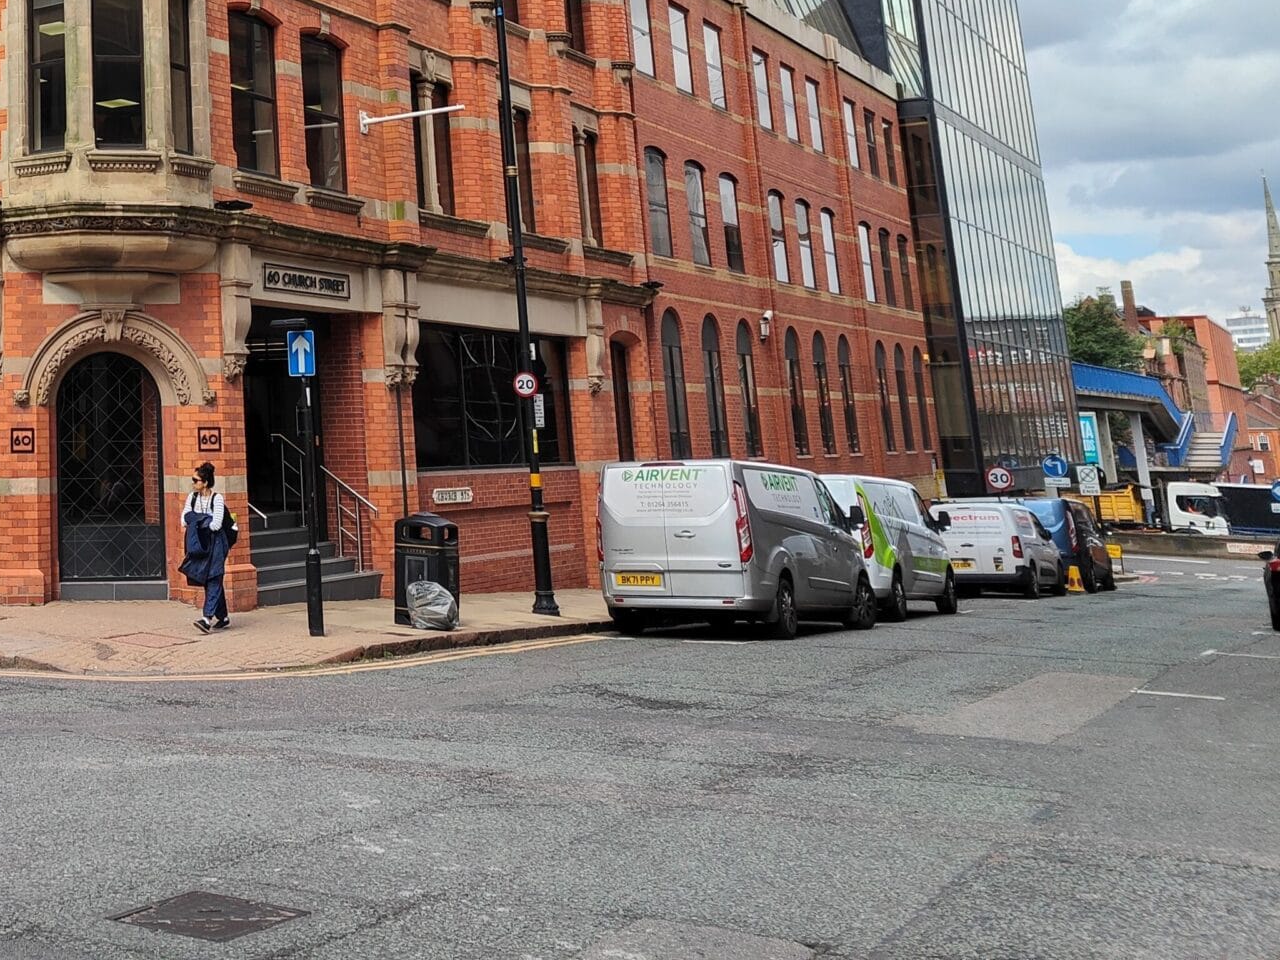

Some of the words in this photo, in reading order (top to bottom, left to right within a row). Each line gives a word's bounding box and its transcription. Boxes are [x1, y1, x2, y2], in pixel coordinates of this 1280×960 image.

[267, 271, 280, 285] 60
[282, 273, 317, 288] CHURCH
[319, 278, 346, 292] STREET
[518, 379, 534, 390] 20
[14, 435, 31, 446] 60
[201, 434, 218, 445] 60
[634, 469, 702, 482] AIRVENT
[990, 473, 1009, 483] 30
[767, 473, 799, 491] AIRVENT
[621, 576, 638, 584] BK71
